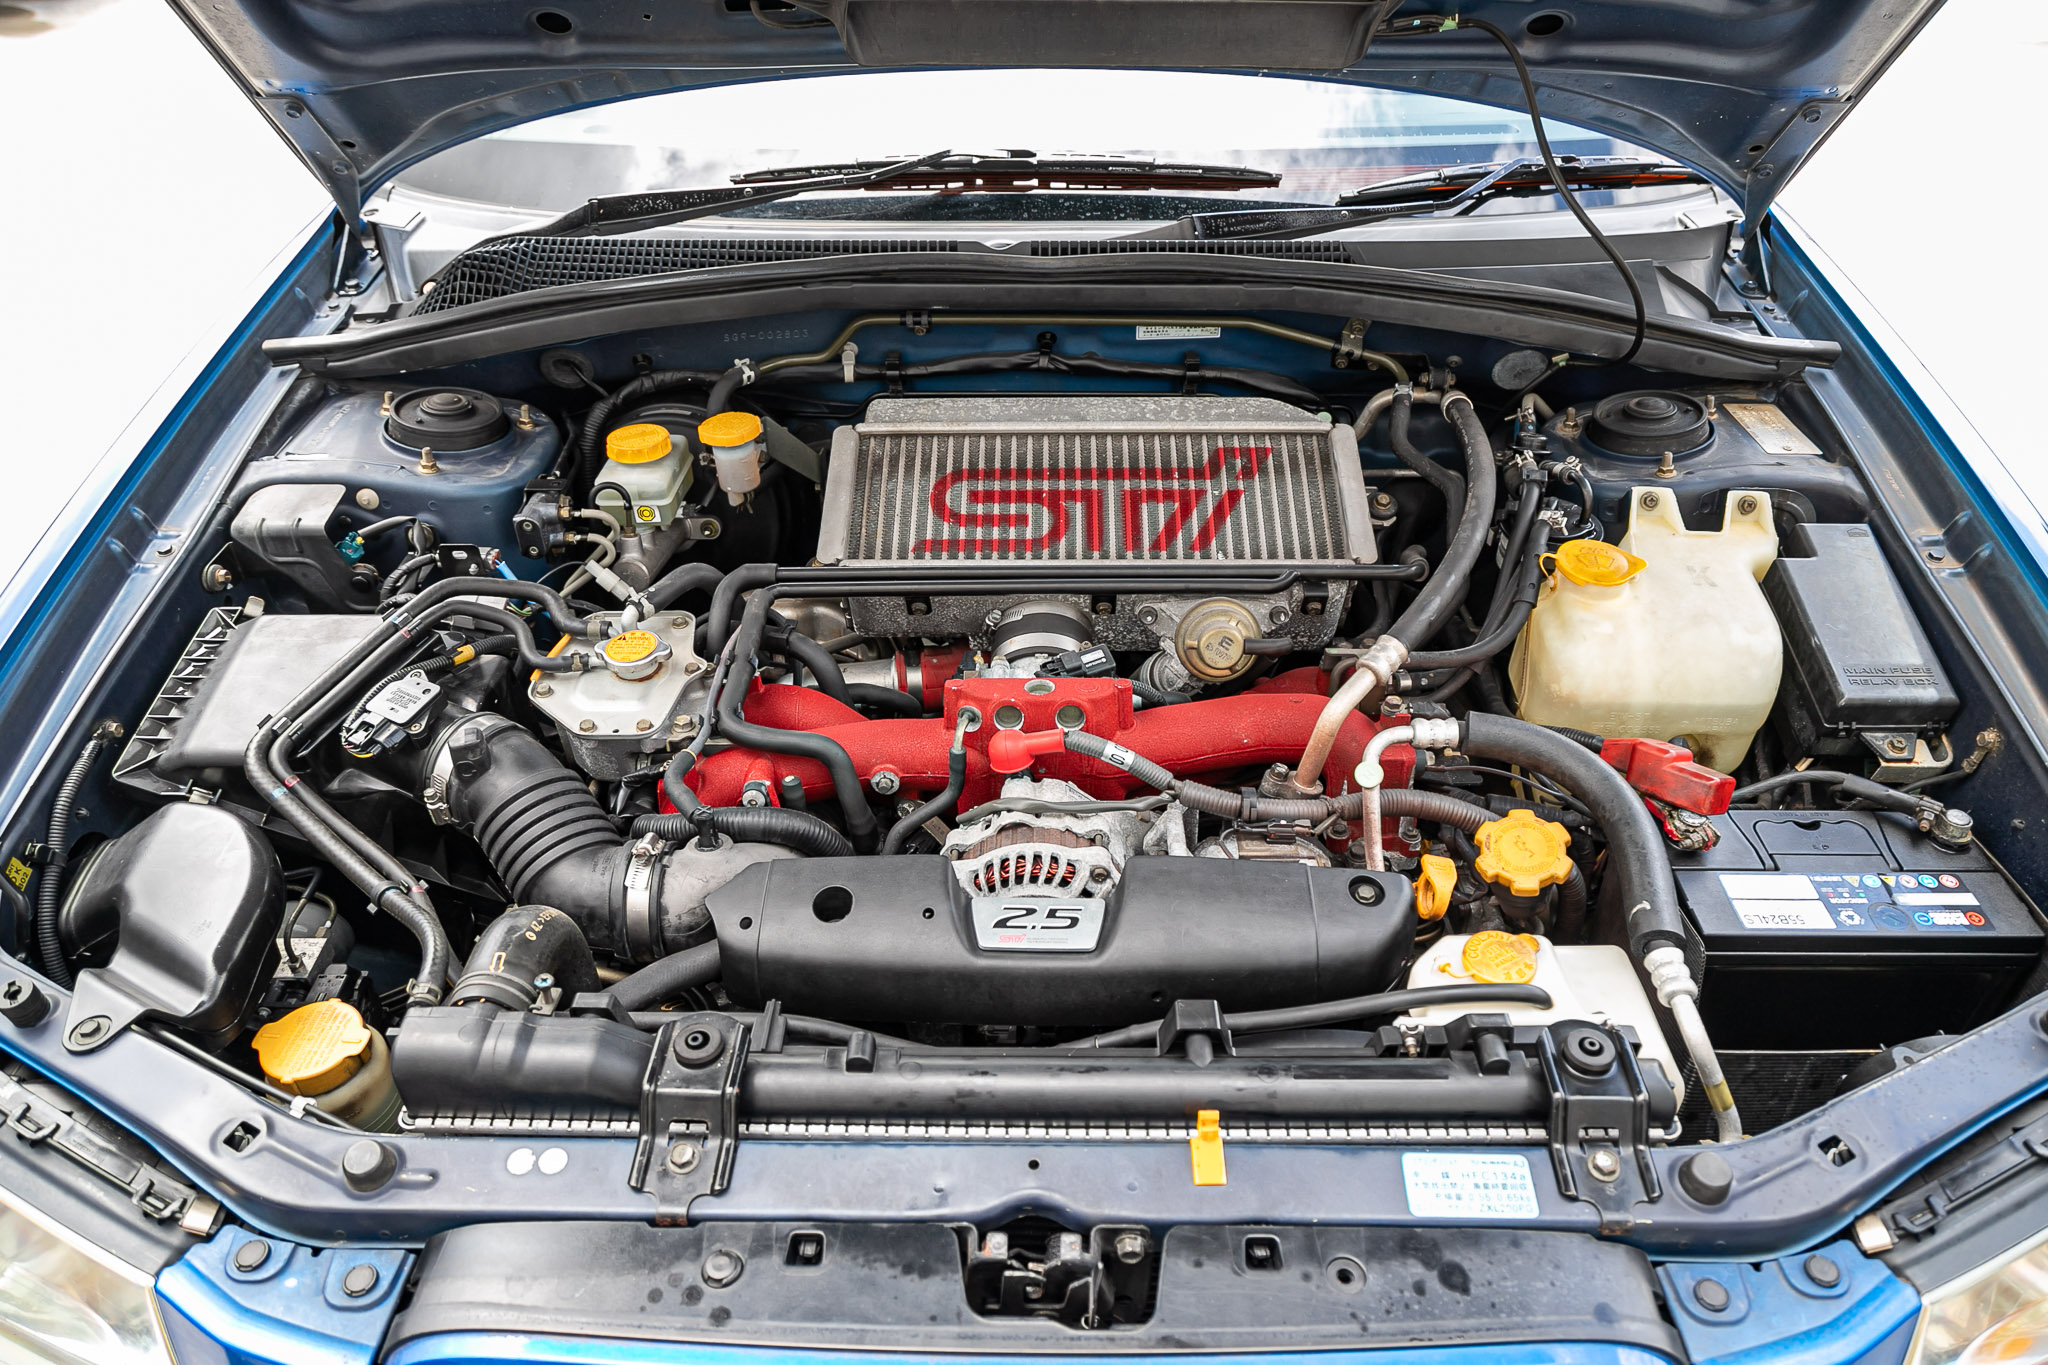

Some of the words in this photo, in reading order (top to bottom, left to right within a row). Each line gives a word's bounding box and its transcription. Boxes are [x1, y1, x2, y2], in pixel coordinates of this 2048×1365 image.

[1843, 666, 1887, 675] MAIN
[1889, 666, 1934, 675] FUSE
[1848, 678, 1898, 686] RELAY
[1903, 678, 1939, 686] BOX
[992, 907, 1083, 930] 2.5
[1745, 913, 1805, 925] 55B24LS
[1461, 1171, 1526, 1181] HFC134a
